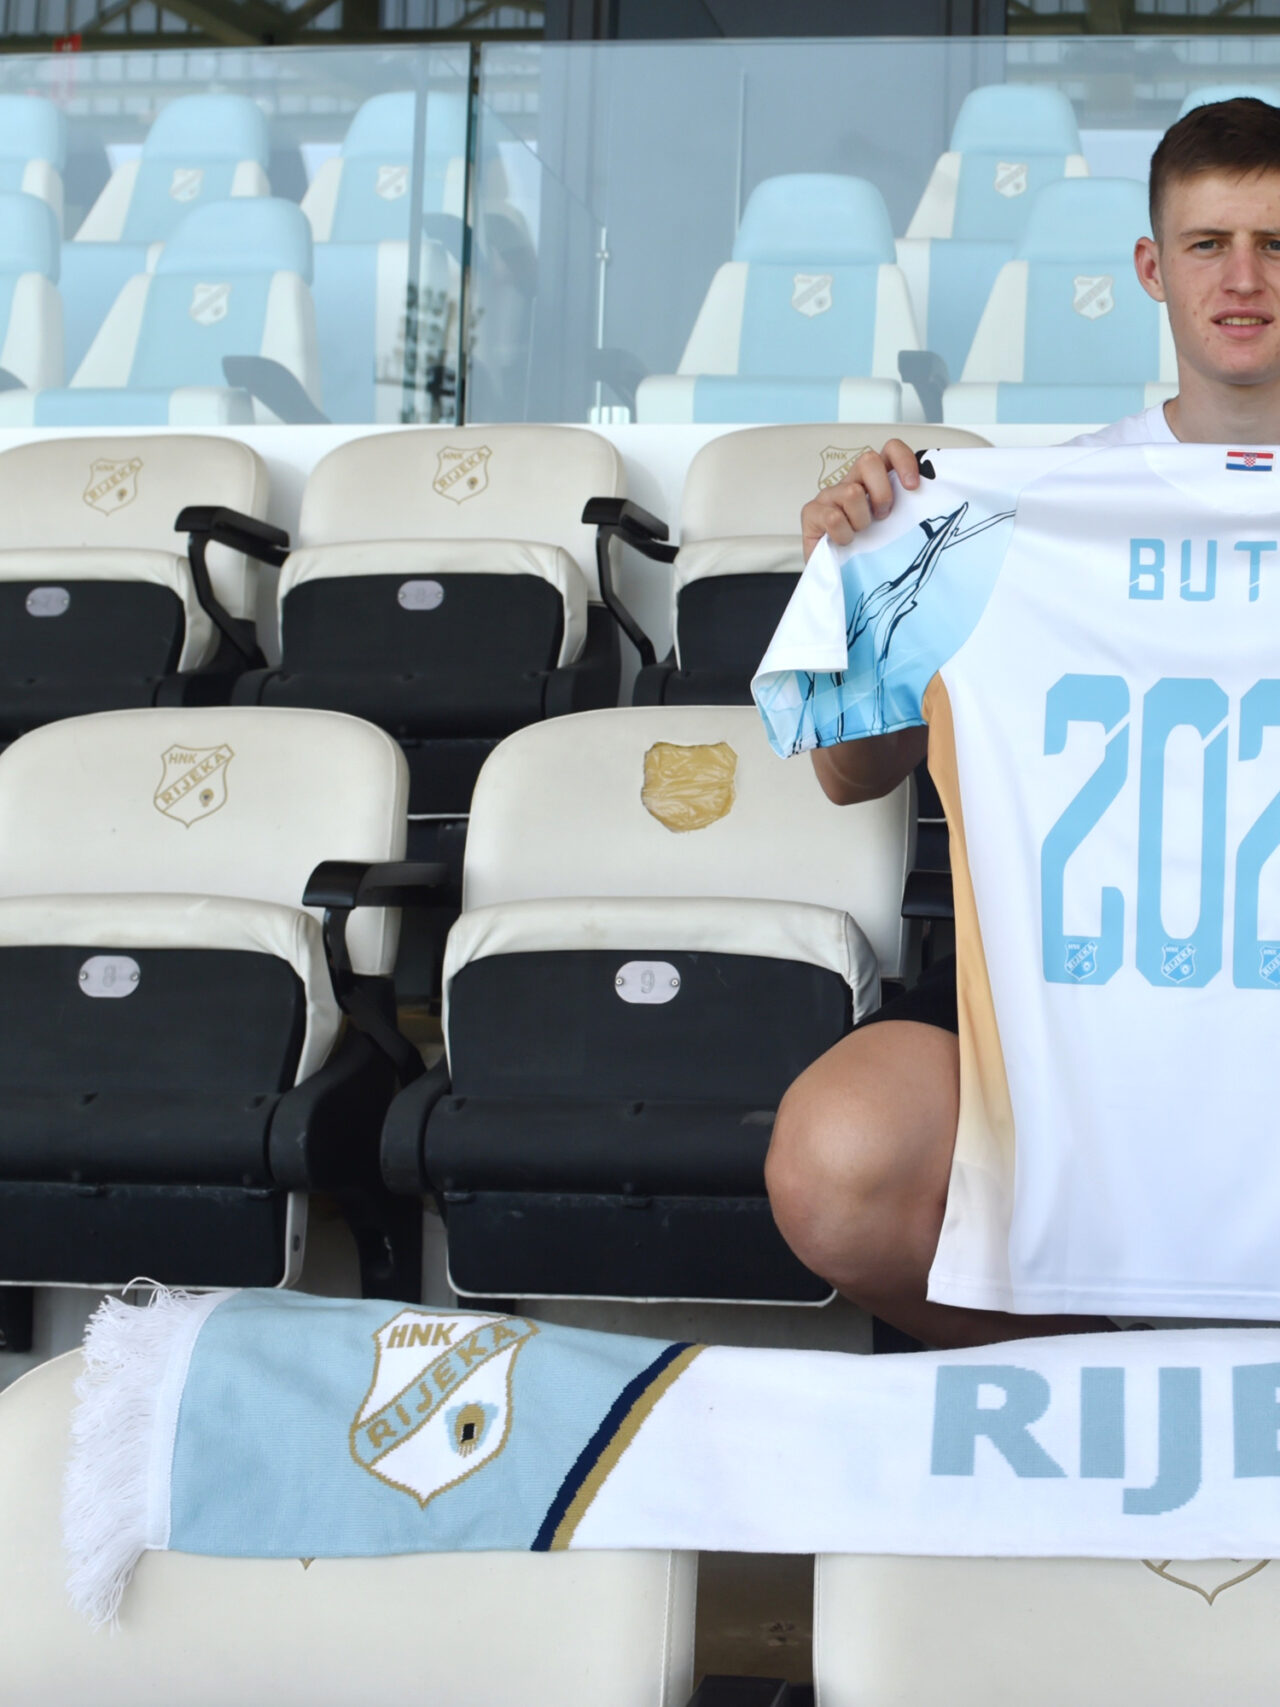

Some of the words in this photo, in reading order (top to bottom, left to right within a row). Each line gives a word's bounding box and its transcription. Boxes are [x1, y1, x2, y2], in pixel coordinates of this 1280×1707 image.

[168, 752, 197, 764] HNK
[160, 752, 226, 805] RIJEKA
[640, 969, 656, 994] 9
[386, 1322, 458, 1349] HNK
[366, 1324, 519, 1449] RIJEKA
